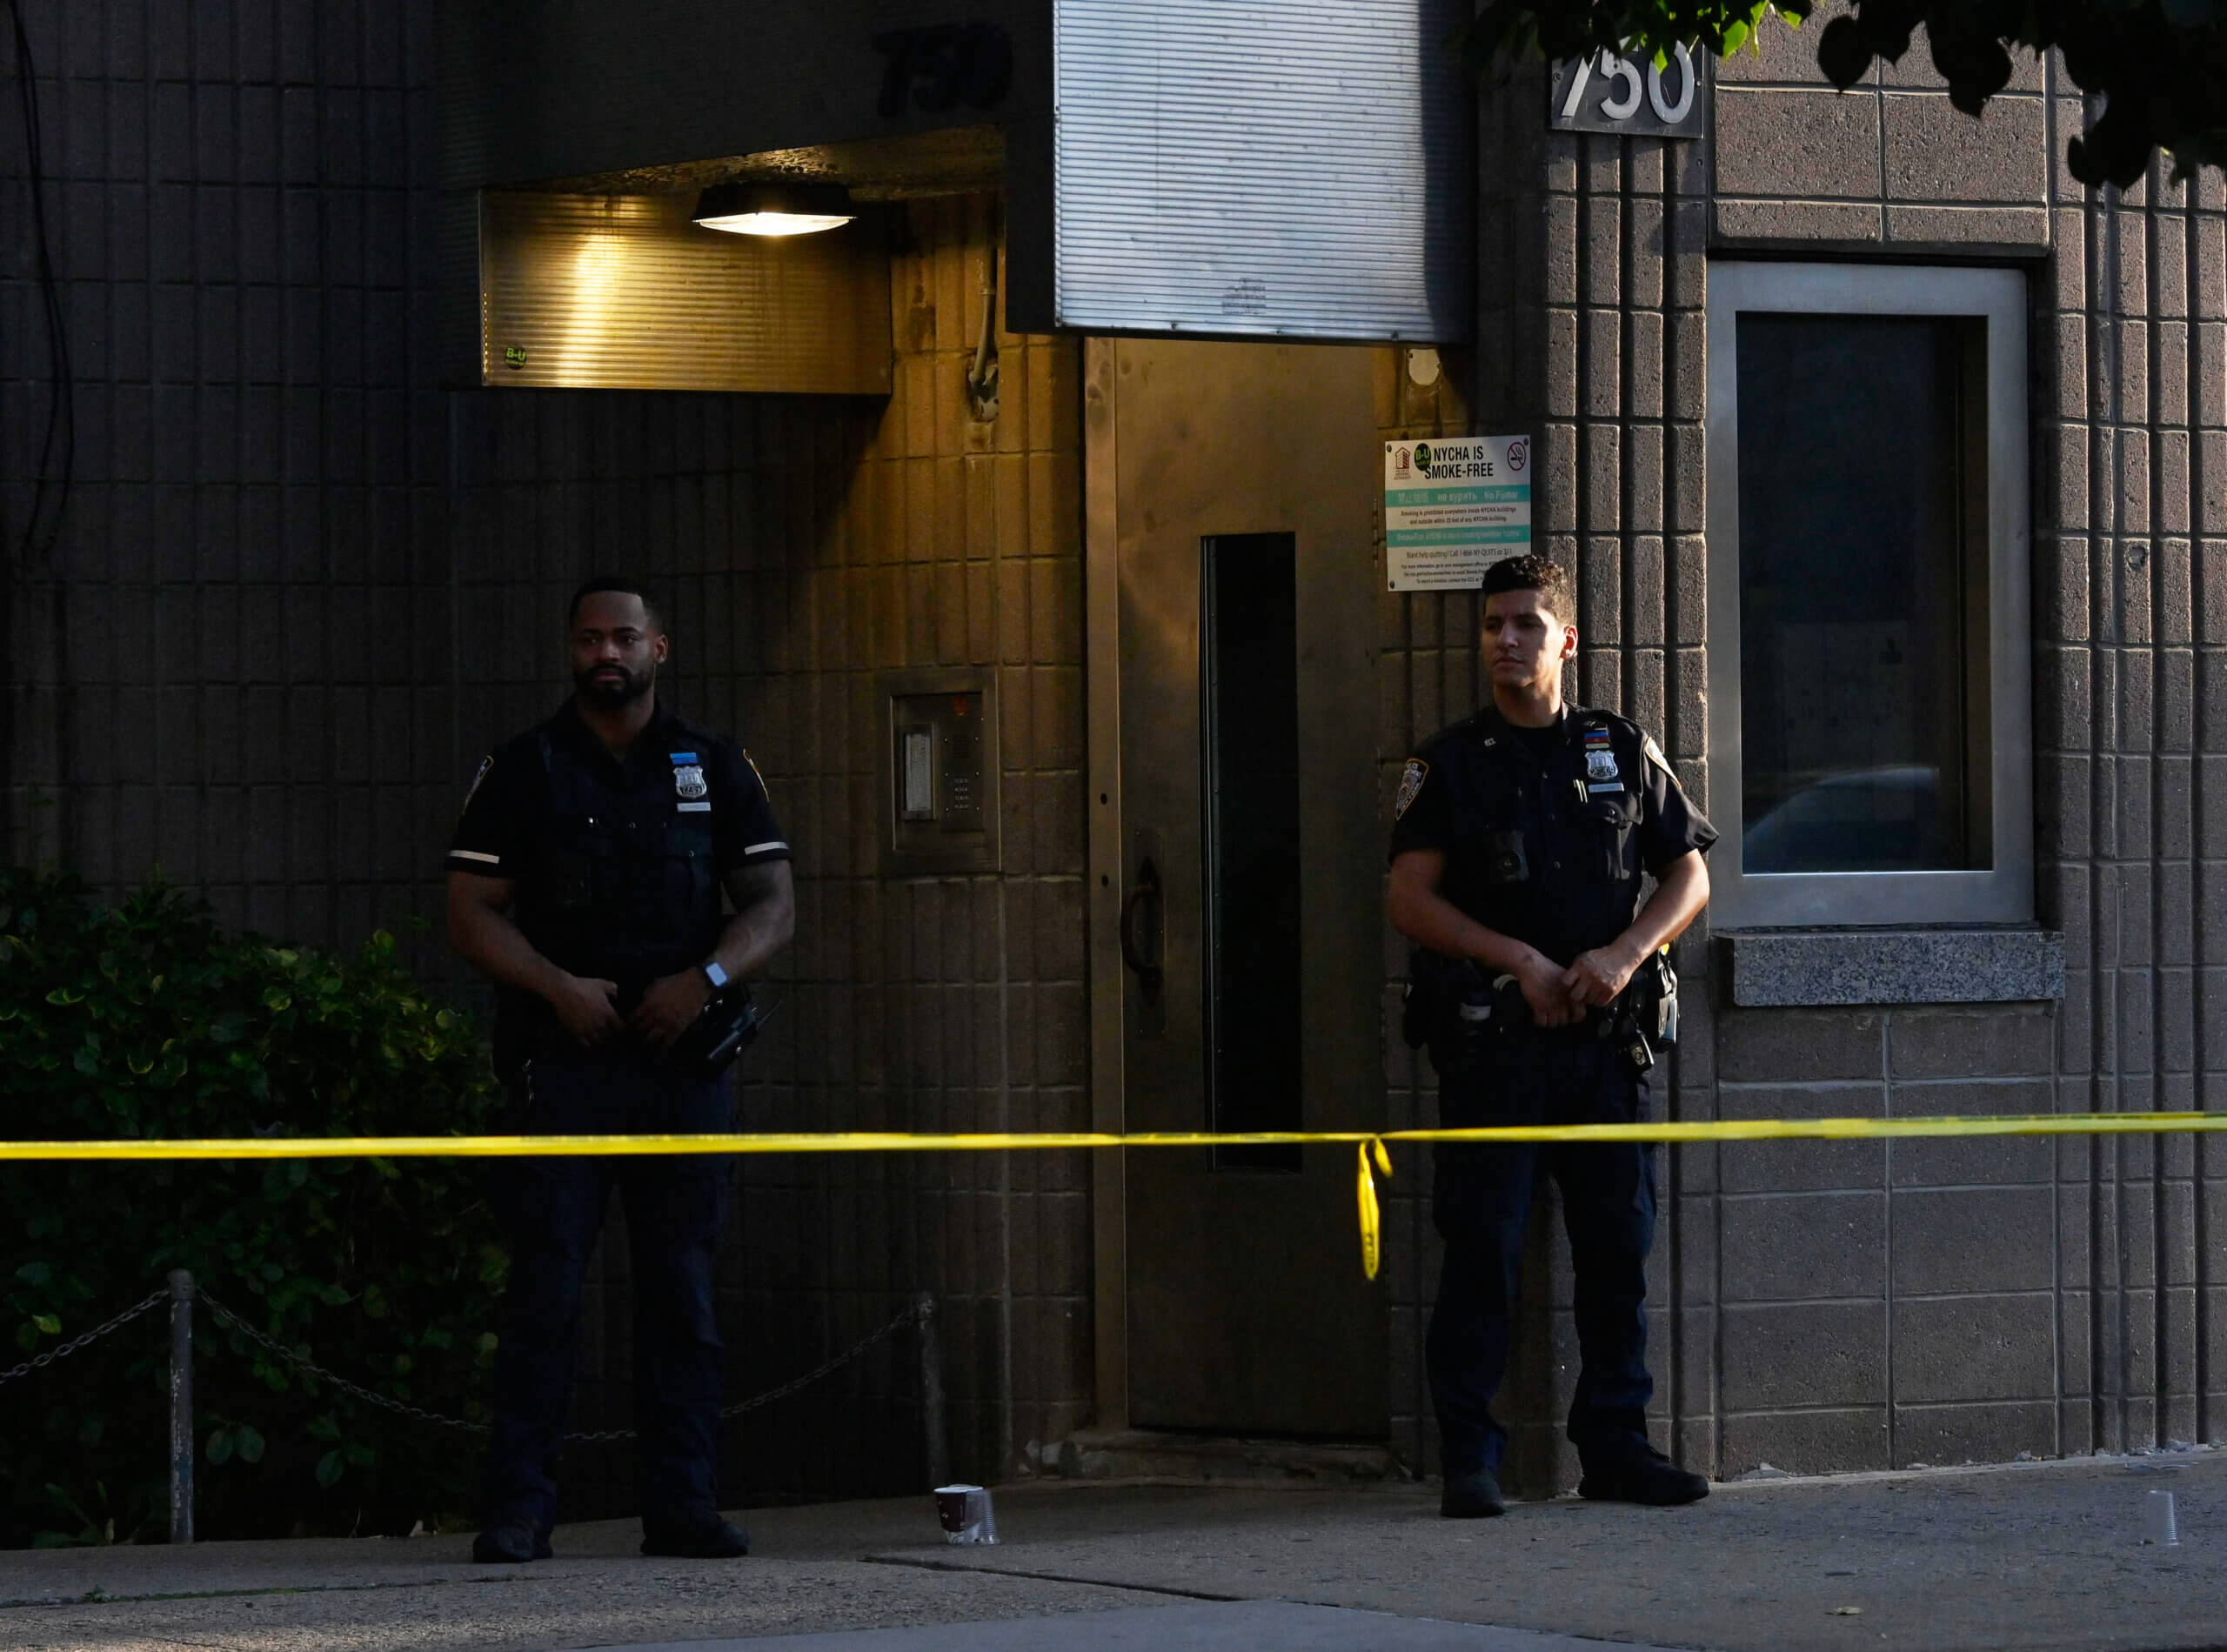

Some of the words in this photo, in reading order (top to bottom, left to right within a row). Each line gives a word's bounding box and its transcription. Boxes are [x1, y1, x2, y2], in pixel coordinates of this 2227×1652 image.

[872, 23, 1012, 117] 750
[1434, 446, 1470, 462] NYCHA
[1474, 445, 1484, 460] IS
[1425, 462, 1494, 479] SMOKE-FREE
